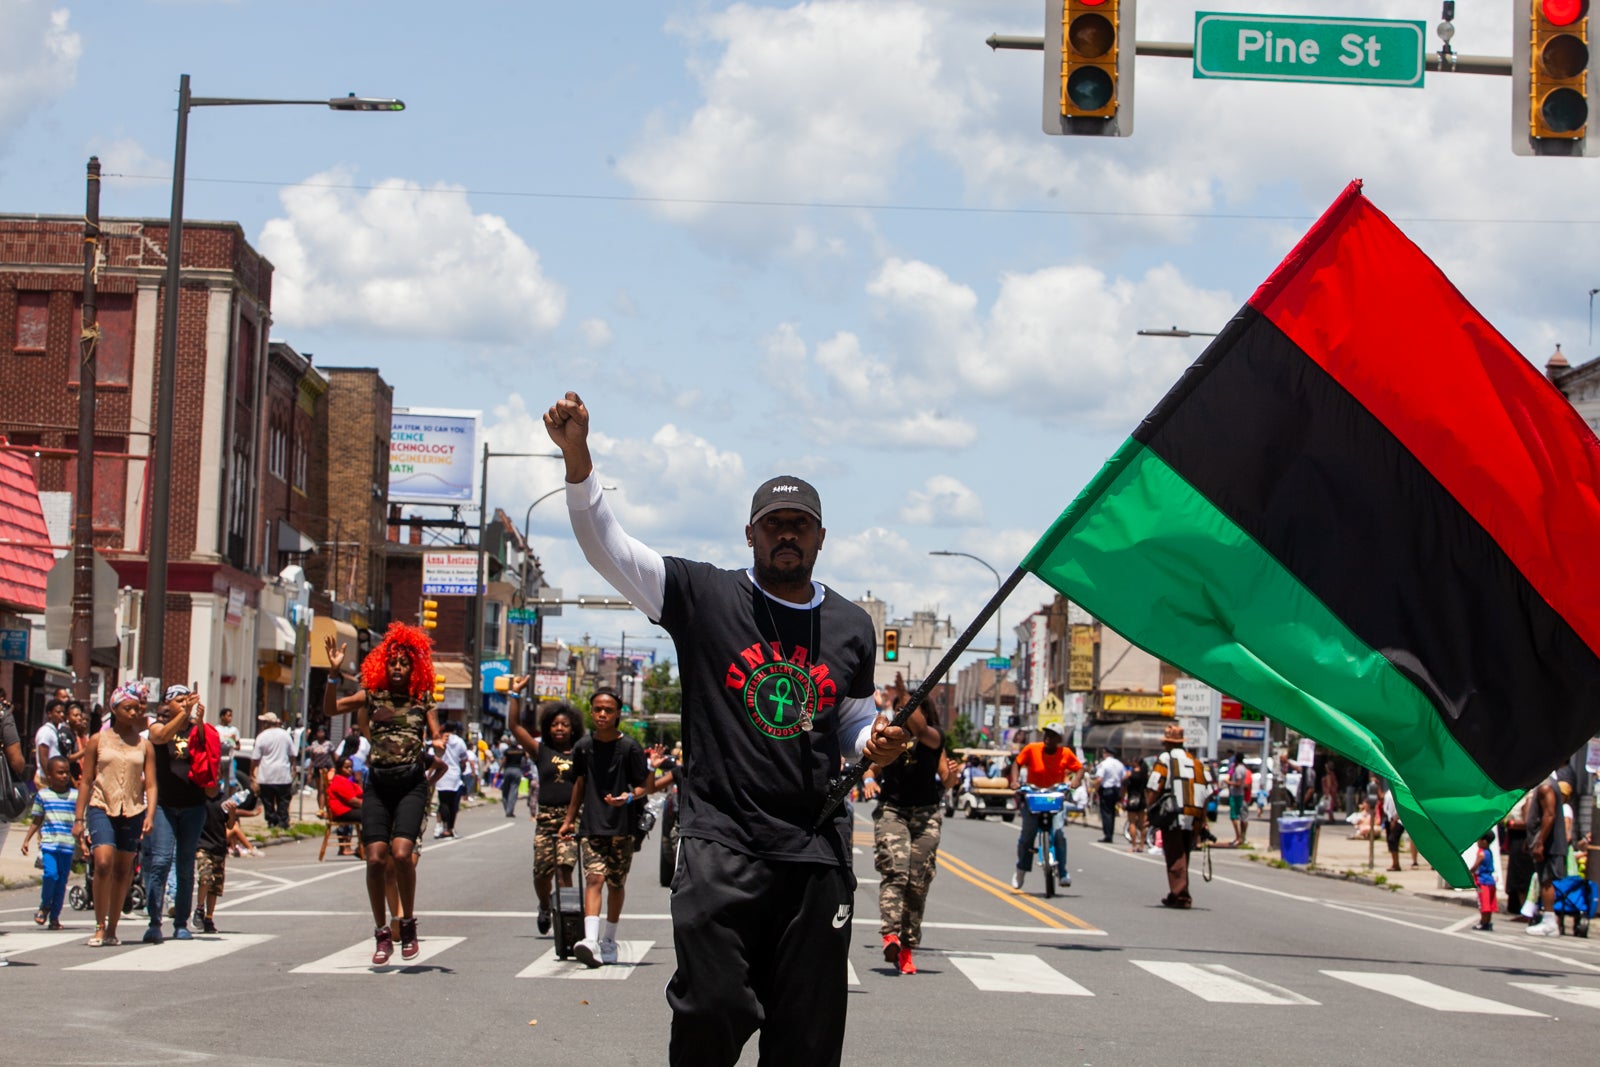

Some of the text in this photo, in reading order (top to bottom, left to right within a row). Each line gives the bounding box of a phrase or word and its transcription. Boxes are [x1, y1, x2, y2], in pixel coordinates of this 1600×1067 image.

[1237, 28, 1382, 67] Pine St
[390, 432, 424, 441] CIENCE
[390, 442, 455, 454] ECHNOLOGY
[389, 453, 453, 465] NGINEERING
[447, 554, 478, 565] Restaura
[747, 671, 767, 709] UNIVERSAL
[1126, 697, 1154, 708] STOP
[752, 712, 801, 736] SSOCIATION
